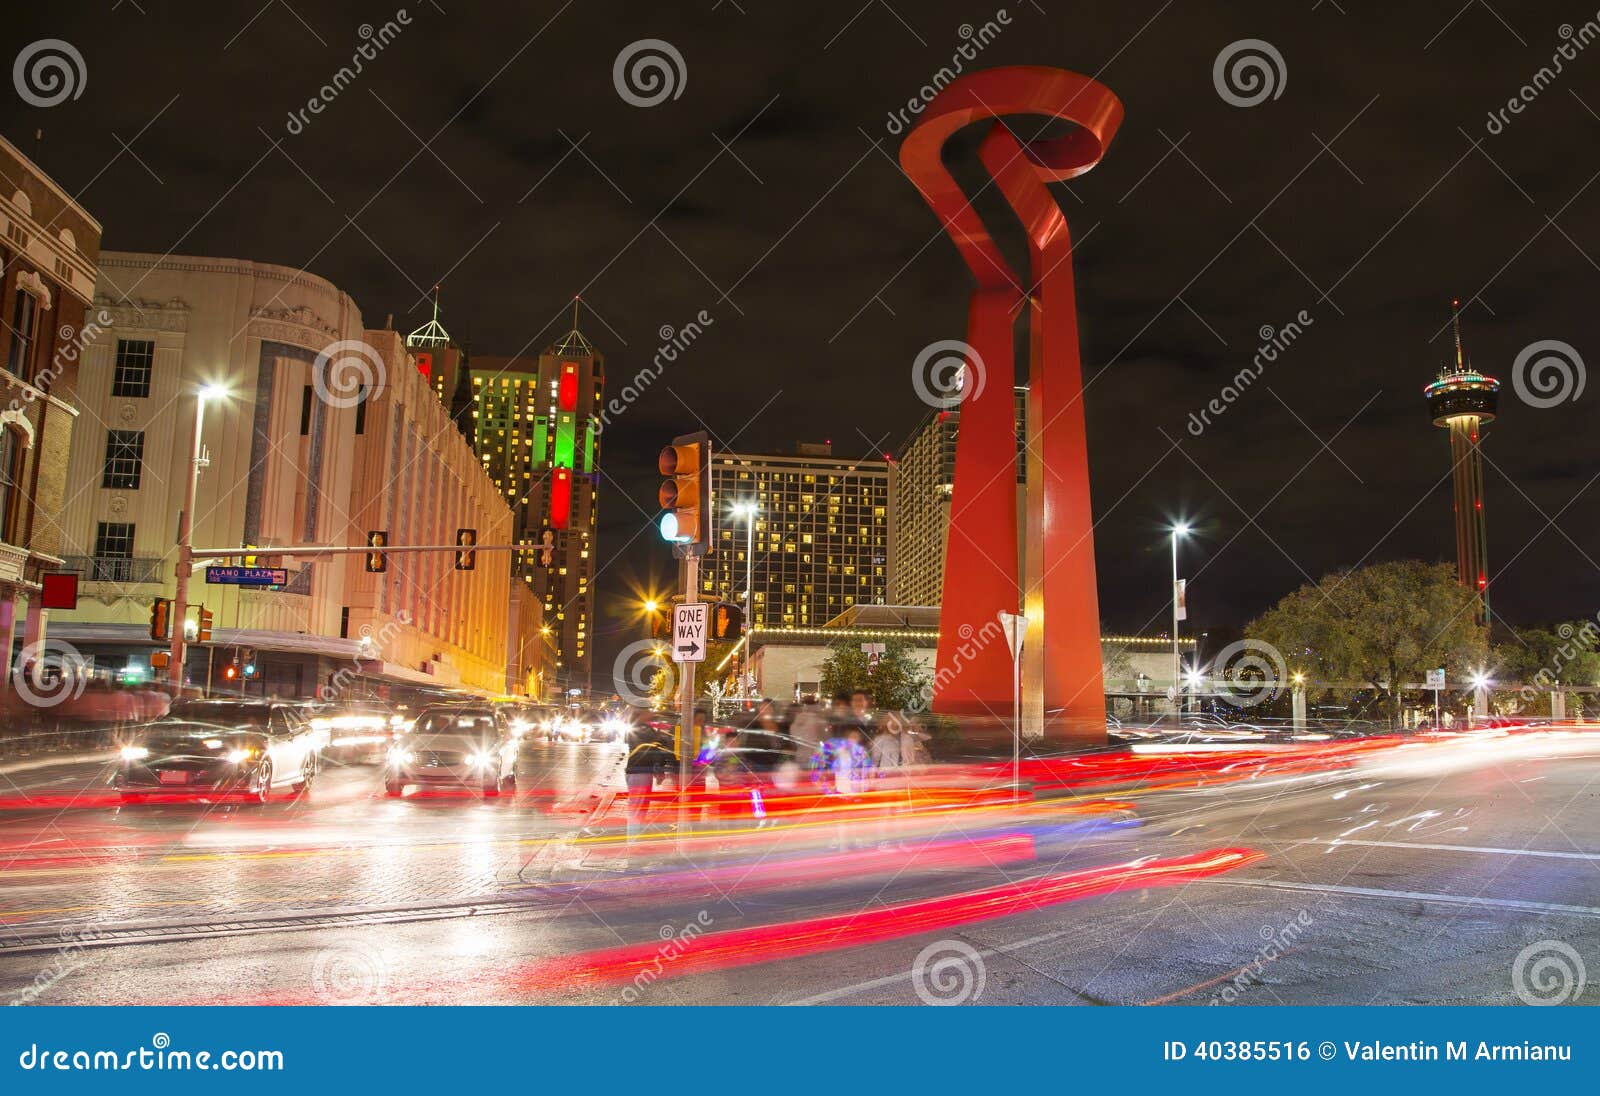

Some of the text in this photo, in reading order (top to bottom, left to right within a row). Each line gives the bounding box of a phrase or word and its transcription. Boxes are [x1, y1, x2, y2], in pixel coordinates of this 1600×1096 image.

[209, 569, 272, 578] ALAMO PLAZA
[679, 609, 703, 623] ONE
[678, 625, 702, 638] WAY
